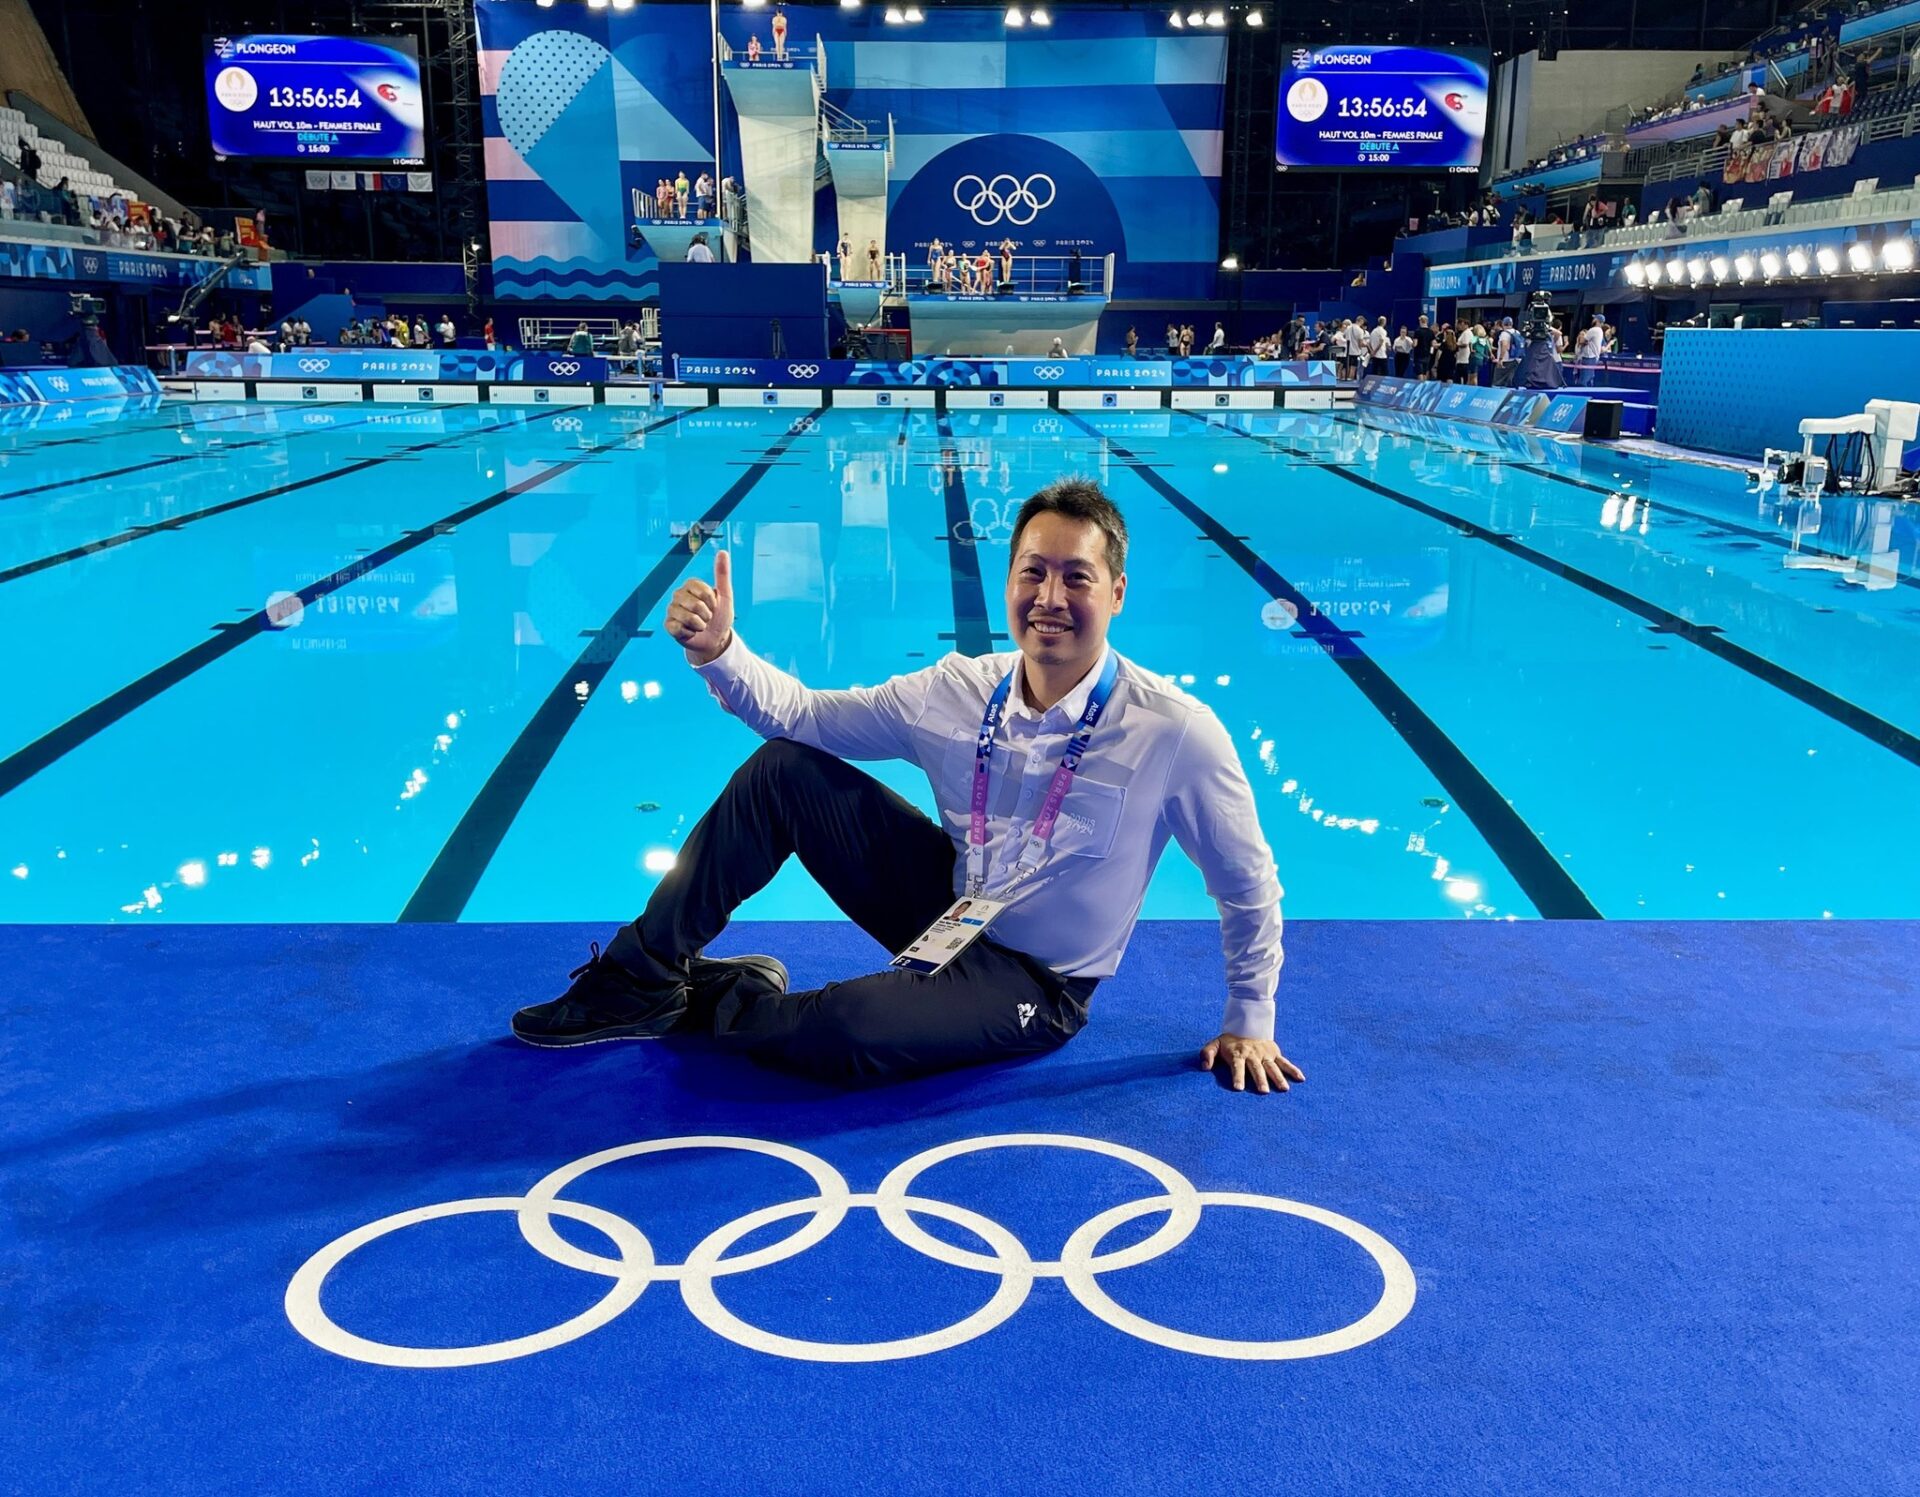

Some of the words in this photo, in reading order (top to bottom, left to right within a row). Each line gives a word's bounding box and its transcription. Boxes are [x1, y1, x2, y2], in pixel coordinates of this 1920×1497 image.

[236, 43, 296, 54] PLONGEON
[1313, 54, 1372, 65] PLONGEON
[269, 86, 362, 108] 13:56:54
[1337, 97, 1428, 118] 13:56:54
[253, 120, 276, 129] HAUT
[277, 121, 295, 129] VOL
[319, 122, 352, 130] FEMMES
[354, 122, 381, 131] FINALE
[1319, 131, 1341, 139] HAUT
[1342, 131, 1359, 139] VOL
[1382, 131, 1415, 139] FEMMES
[1416, 131, 1443, 140] FINALE
[308, 144, 330, 153] 15:00
[1368, 154, 1390, 162] 15:00
[119, 260, 144, 277] PARIS
[146, 262, 168, 278] 2024
[1550, 264, 1572, 282] PARIS
[1574, 263, 1596, 281] 2024
[362, 362, 398, 371] PARIS
[401, 363, 433, 371] 2024
[686, 366, 721, 374] PARIS
[1096, 369, 1130, 377] PARIS
[988, 703, 998, 722] Atos
[1086, 701, 1100, 722] Atos
[1050, 774, 1068, 807] PARIS
